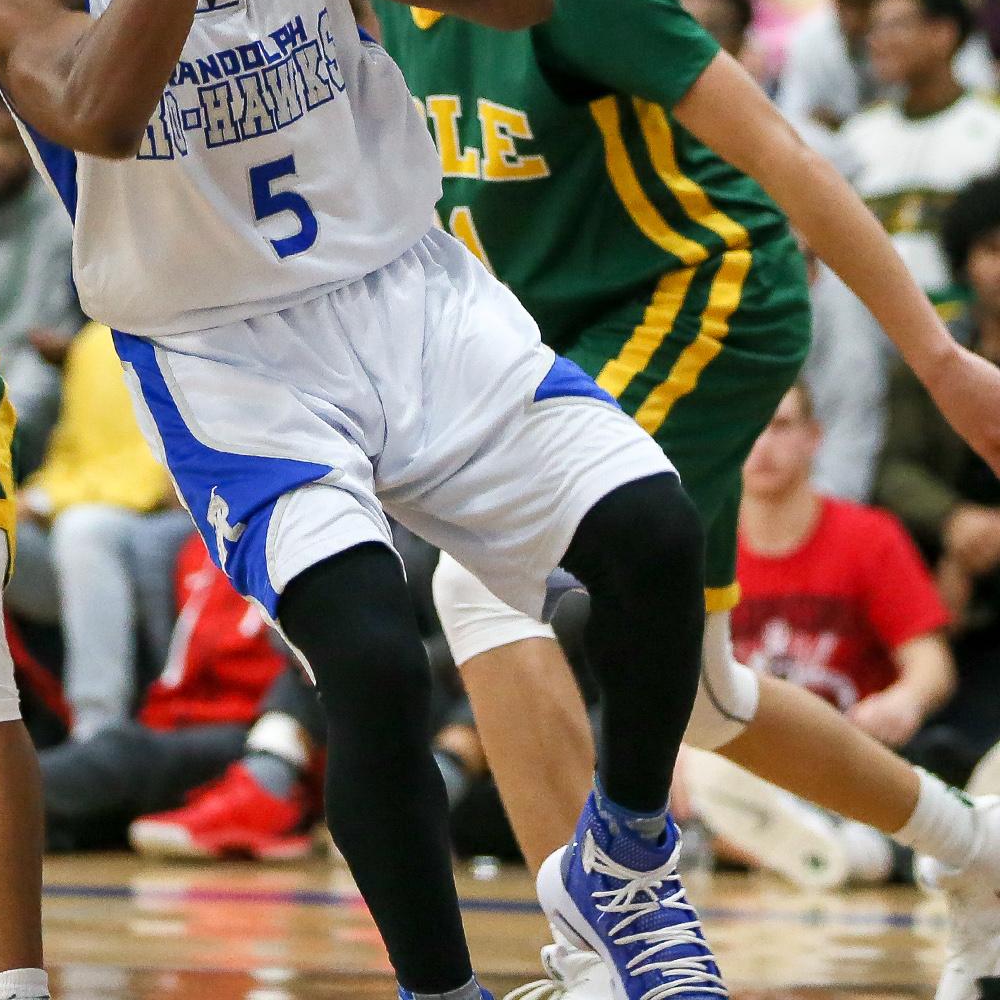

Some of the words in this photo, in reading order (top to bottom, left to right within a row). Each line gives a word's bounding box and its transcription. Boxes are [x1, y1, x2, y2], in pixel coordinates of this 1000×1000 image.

[168, 14, 309, 87] ANDOLPH
[412, 94, 551, 182] LE
[249, 154, 319, 261] 5
